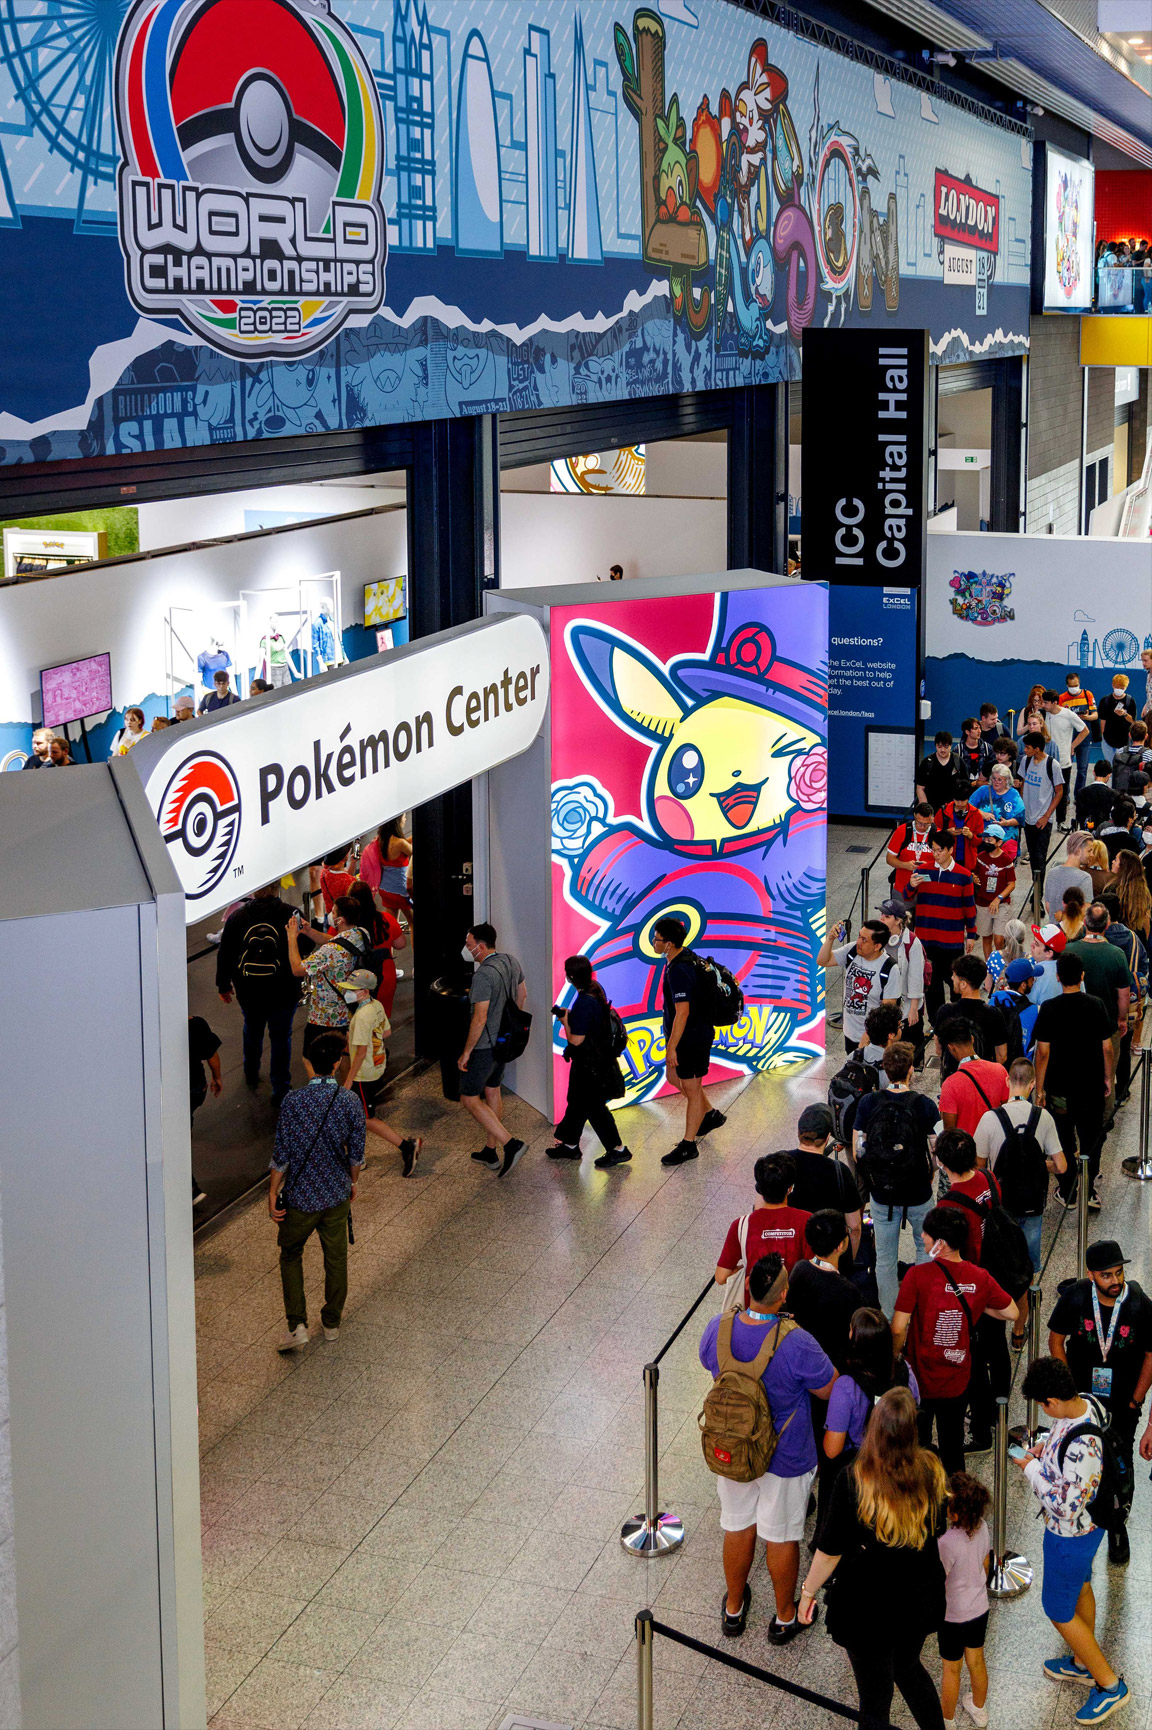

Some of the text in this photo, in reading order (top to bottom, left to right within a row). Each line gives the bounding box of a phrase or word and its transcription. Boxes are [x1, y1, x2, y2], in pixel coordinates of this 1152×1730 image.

[132, 180, 377, 260] WORLD
[939, 185, 996, 234] LONDON
[143, 253, 374, 294] CHAMPIONSHIPS
[947, 256, 973, 275] AUGUST
[978, 256, 985, 276] 18
[977, 291, 985, 311] 21
[239, 308, 301, 333] 2022
[877, 347, 908, 419] Hall
[118, 391, 194, 418] RILLABOOM'S
[462, 401, 507, 416] August 18-21
[119, 416, 212, 454] SLAM
[875, 434, 913, 568] Capital
[835, 497, 865, 565] ICC
[831, 636, 883, 646] questions?
[841, 660, 865, 668] ExCeL
[866, 661, 897, 670] website
[866, 670, 874, 678] to
[875, 671, 893, 680] help
[839, 678, 852, 686] the
[853, 679, 870, 687] best
[885, 680, 894, 688] of
[258, 663, 541, 827] Pokémon Center
[233, 864, 245, 879] TM
